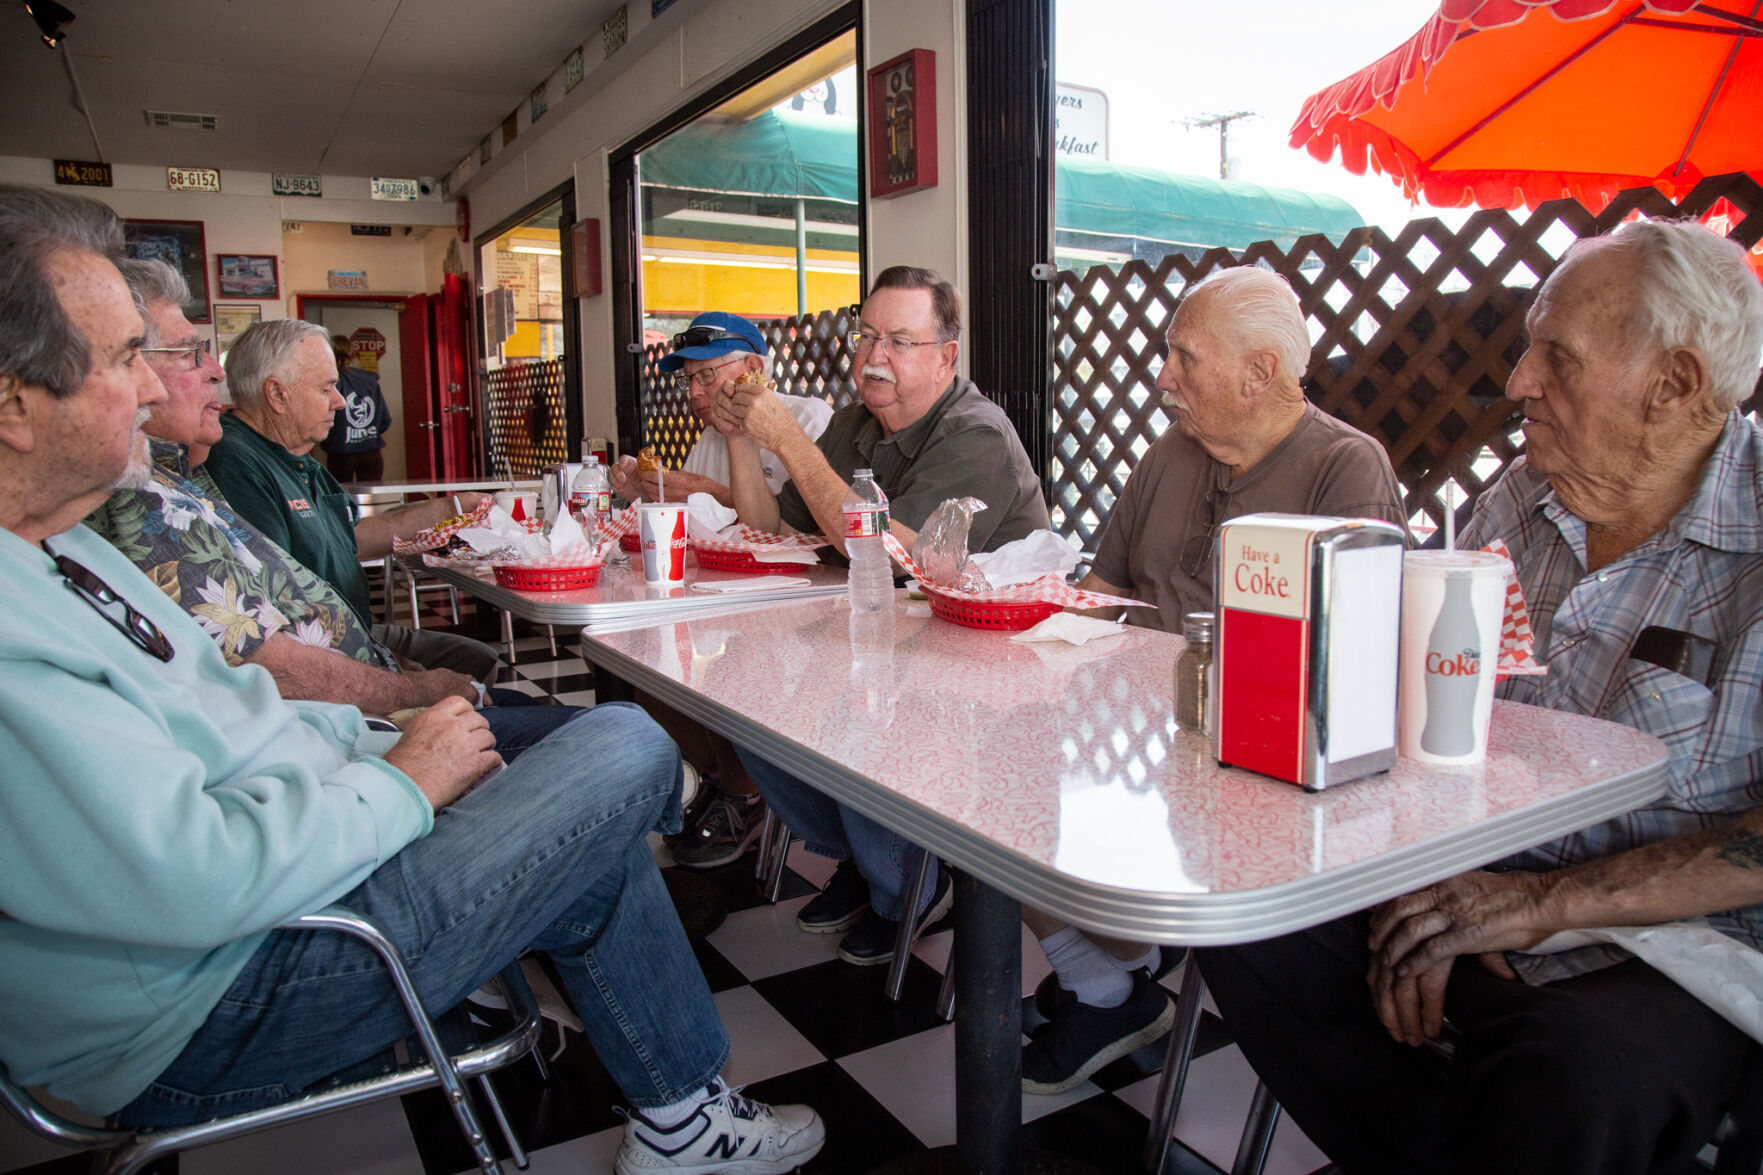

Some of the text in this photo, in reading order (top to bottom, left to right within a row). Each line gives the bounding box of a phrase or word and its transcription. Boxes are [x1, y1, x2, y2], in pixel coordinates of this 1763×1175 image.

[81, 167, 109, 182] 2001
[352, 340, 385, 352] STOP
[1242, 545, 1280, 564] Have a
[1234, 563, 1289, 598] Coke
[1425, 651, 1480, 677] Coke
